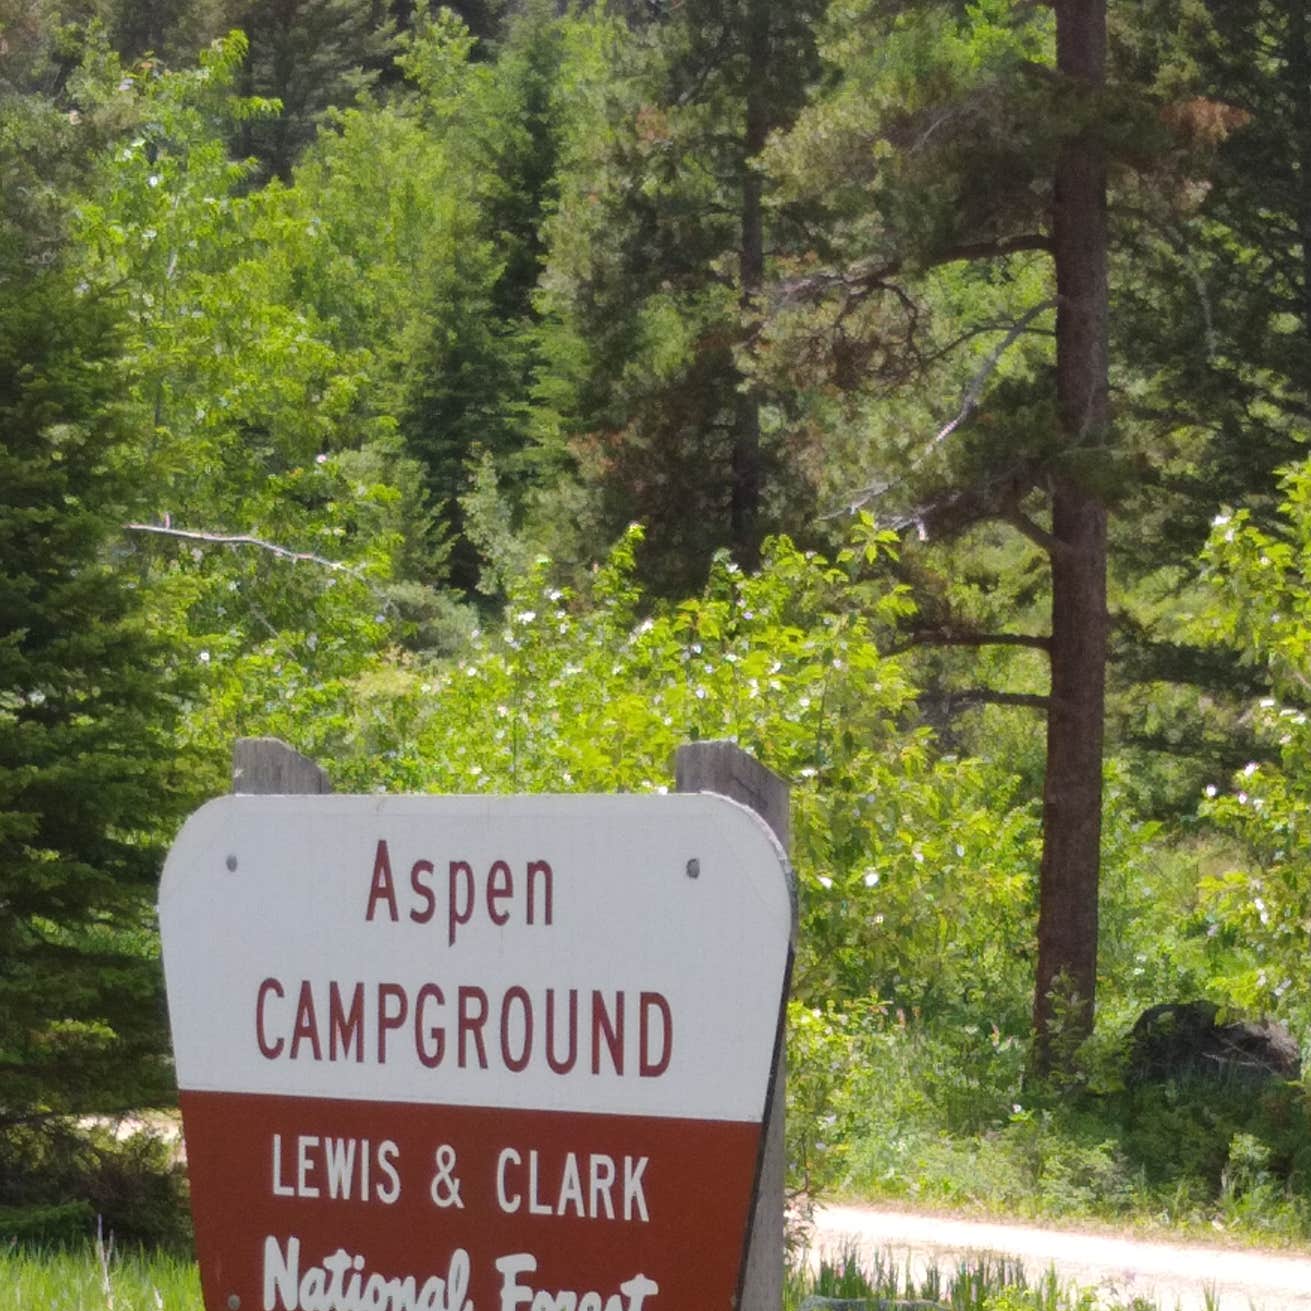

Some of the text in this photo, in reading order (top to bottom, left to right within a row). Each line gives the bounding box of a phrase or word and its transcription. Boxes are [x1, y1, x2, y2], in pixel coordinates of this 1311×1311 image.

[366, 839, 553, 947] Aspen
[256, 977, 673, 1078] CAMPGROUND
[273, 1134, 650, 1222] LEWIS & CLARK
